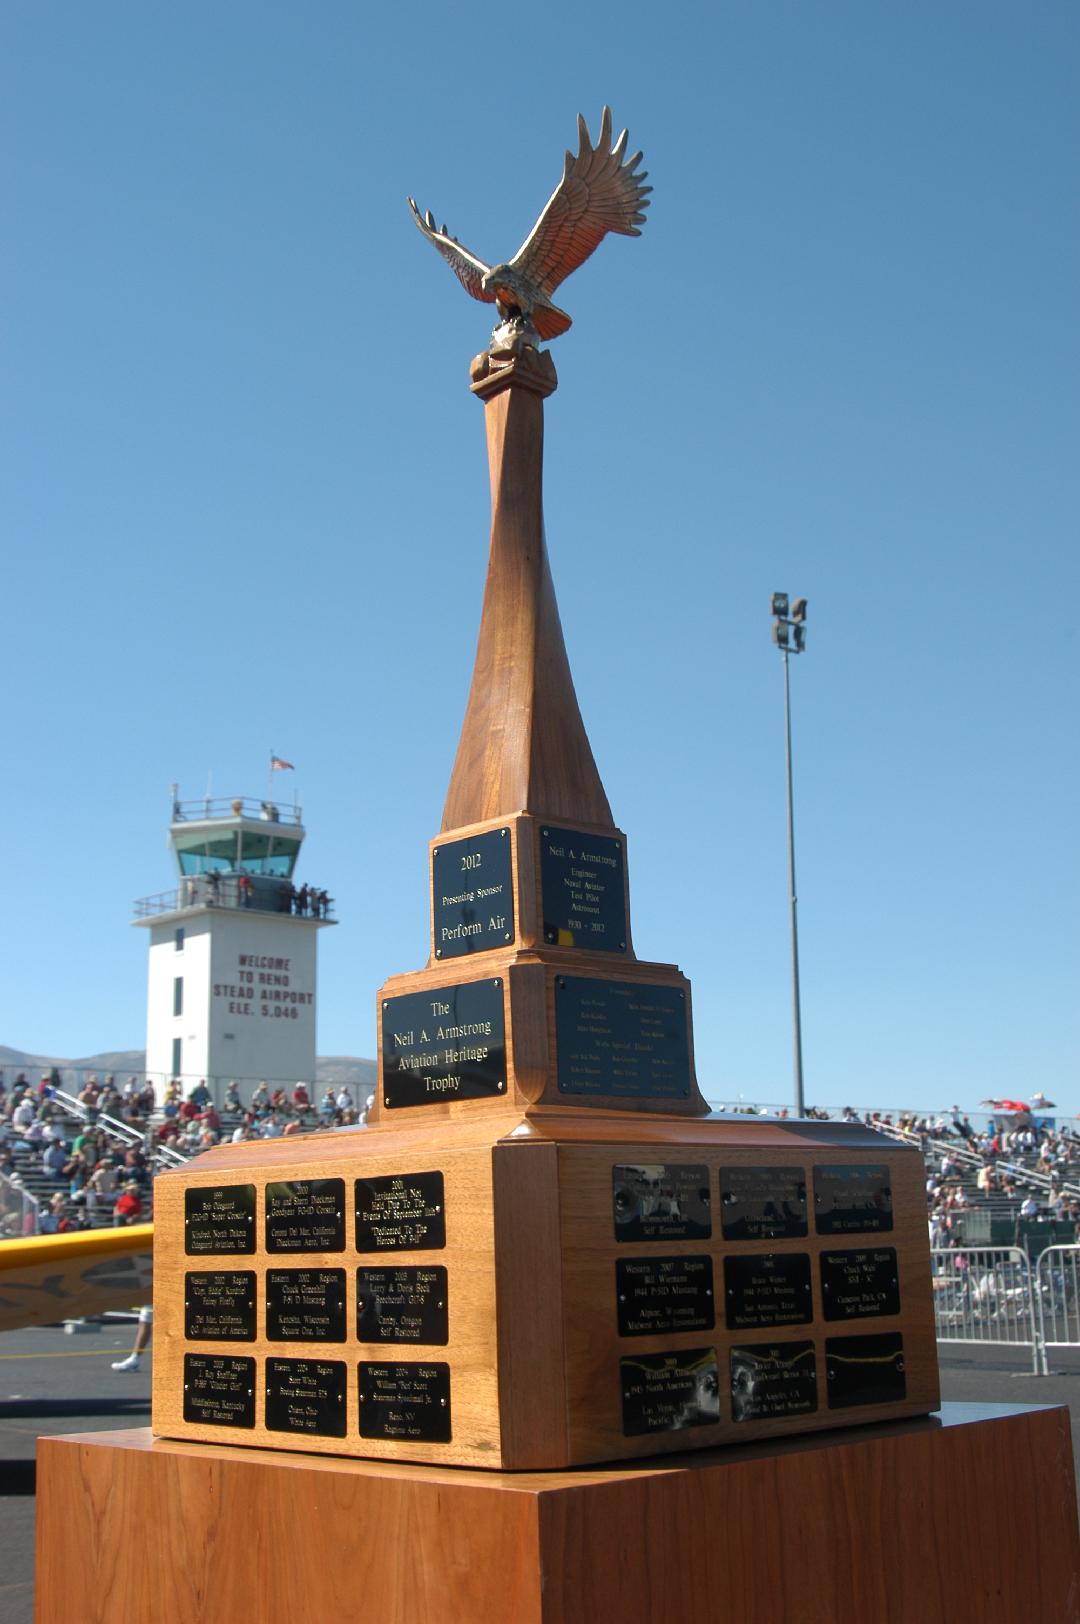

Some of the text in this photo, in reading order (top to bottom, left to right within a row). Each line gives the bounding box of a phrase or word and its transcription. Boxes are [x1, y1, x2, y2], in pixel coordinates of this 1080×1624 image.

[461, 853, 482, 871] 2012
[549, 845, 565, 857] Neil
[581, 851, 618, 868] Armstrong
[571, 867, 597, 879] Engineer
[442, 885, 503, 906] Presenting Sponsor
[442, 915, 505, 941] Perform Air
[238, 954, 291, 971] WELCOME
[239, 971, 290, 987] TO RENO
[214, 984, 313, 1005] STEAD AIRPORT
[229, 1002, 255, 1016] ELE.
[431, 1002, 450, 1017] The
[393, 1021, 492, 1047] Neil A. Armstrong
[398, 1046, 488, 1070] Aviation Heritage
[424, 1074, 461, 1092] Trophy
